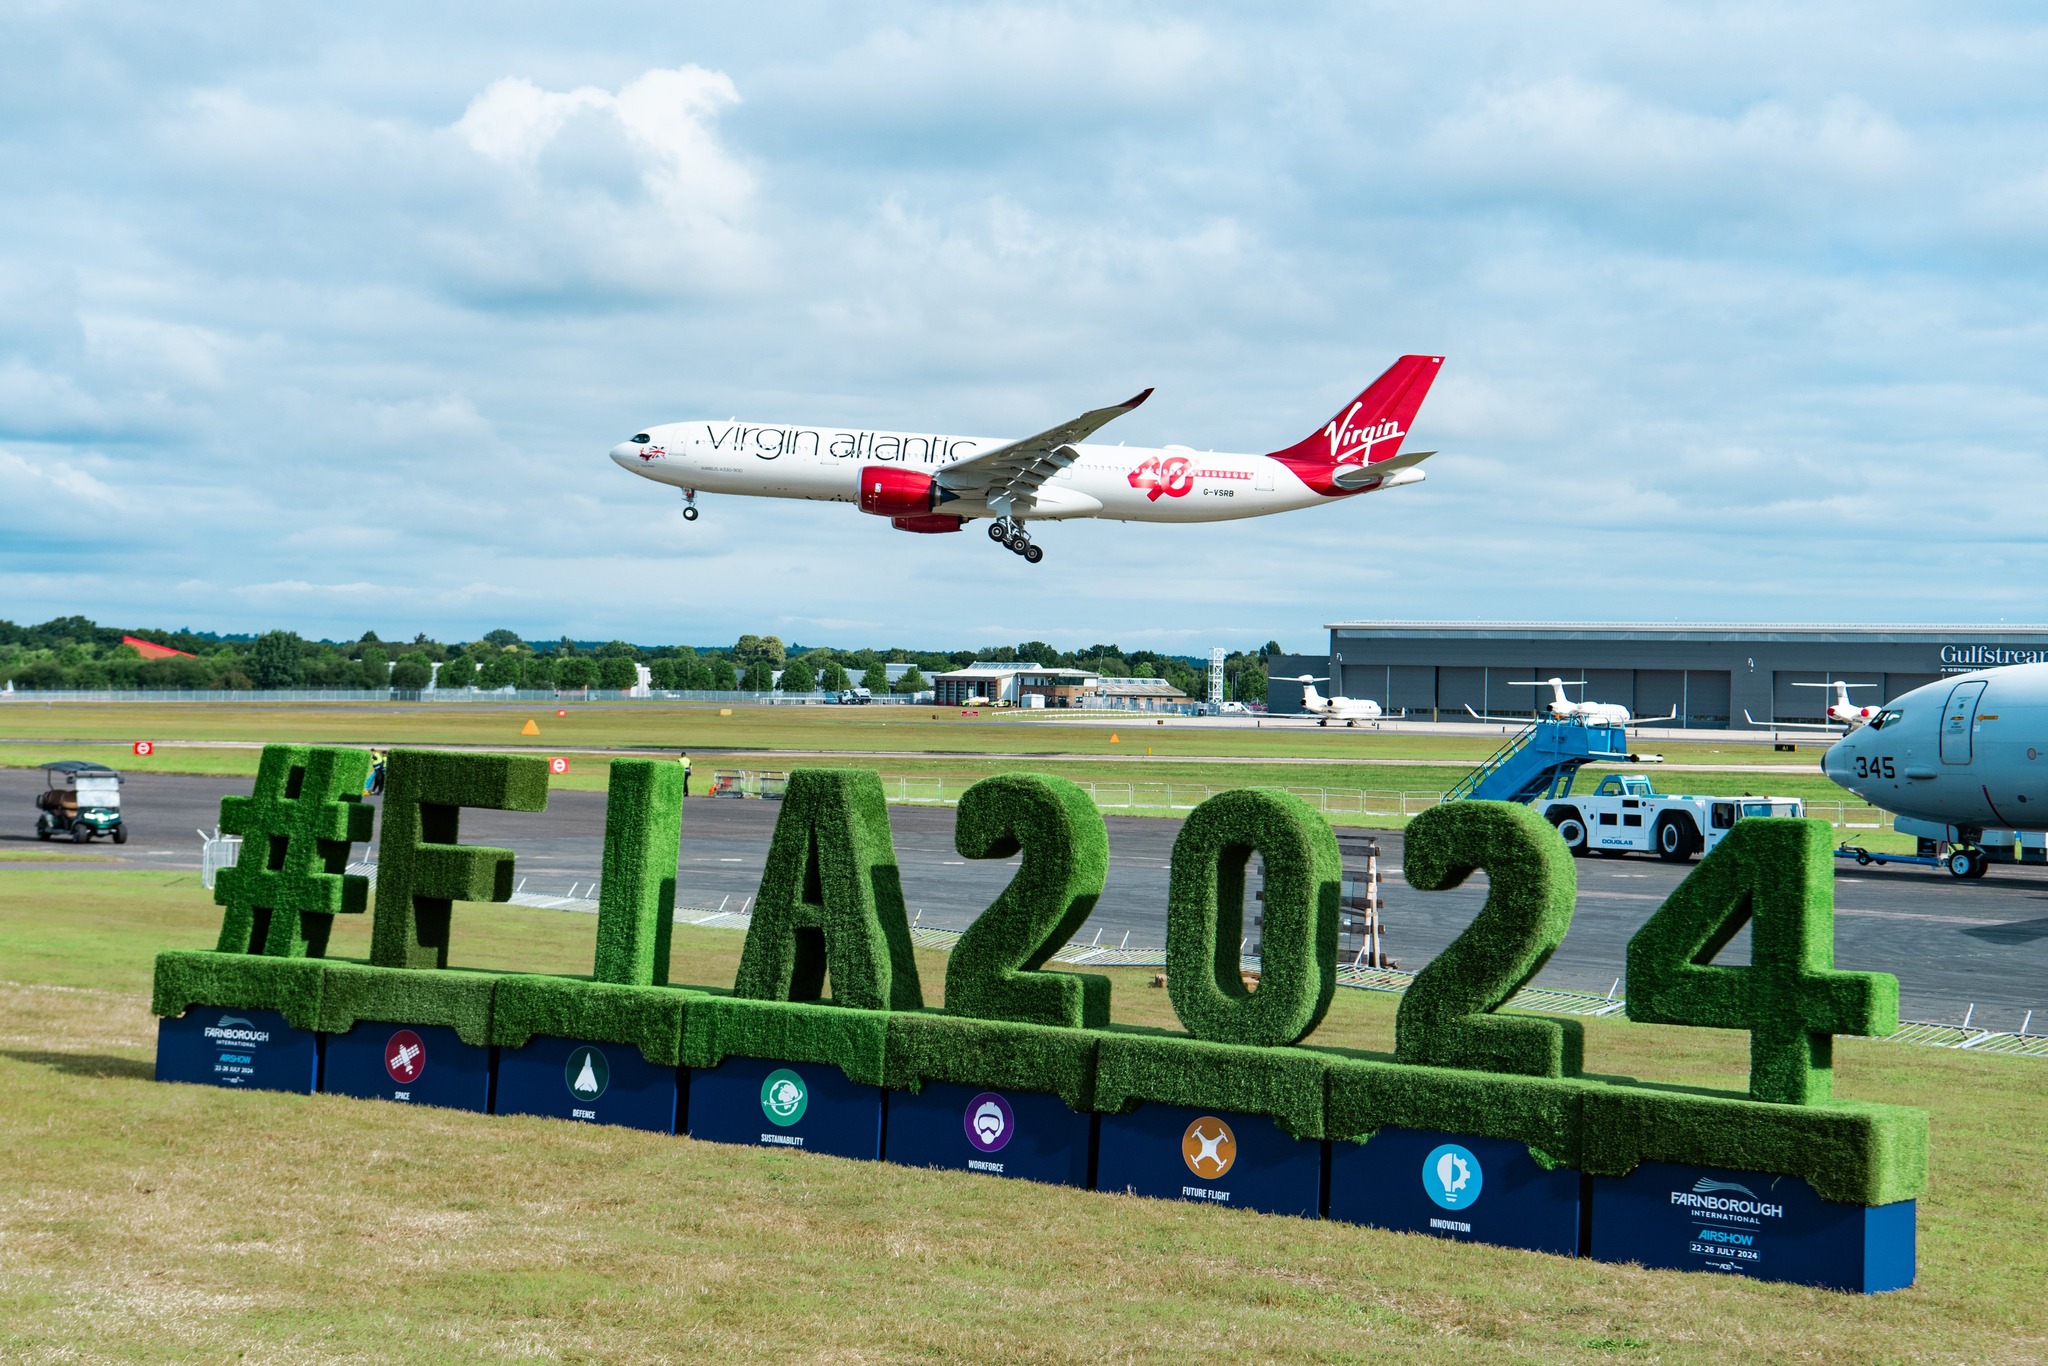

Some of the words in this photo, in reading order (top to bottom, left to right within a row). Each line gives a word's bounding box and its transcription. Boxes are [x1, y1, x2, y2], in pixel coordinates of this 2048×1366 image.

[1323, 401, 1405, 467] Virgin
[829, 432, 977, 465] atlantic
[1127, 456, 1194, 502] 40
[1203, 488, 1235, 498] G-VSRB
[1855, 756, 1896, 779] 345
[1602, 838, 1633, 846] DOUGLAS
[204, 1027, 269, 1042] FARNBOROUGH
[215, 1039, 256, 1048] INTERNATIONAL
[219, 1053, 252, 1064] AIRSHOW
[395, 1091, 410, 1100] SPACE
[572, 1108, 596, 1120] DEFENCE
[761, 1133, 804, 1146] SUSTAINABILITY
[968, 1159, 1004, 1172] WORKFORCE
[1182, 1186, 1206, 1199] FUTURE
[1208, 1189, 1230, 1202] FLIGHT
[1670, 1191, 1783, 1218] FARNBOROUGH
[1691, 1209, 1761, 1225] INTERNATIONAL
[1430, 1218, 1471, 1233] INNOVATION
[1698, 1229, 1754, 1246] AIRSHOW
[1691, 1243, 1715, 1254] 22-26
[1716, 1247, 1736, 1257] JULY
[1737, 1250, 1758, 1260] 2024
